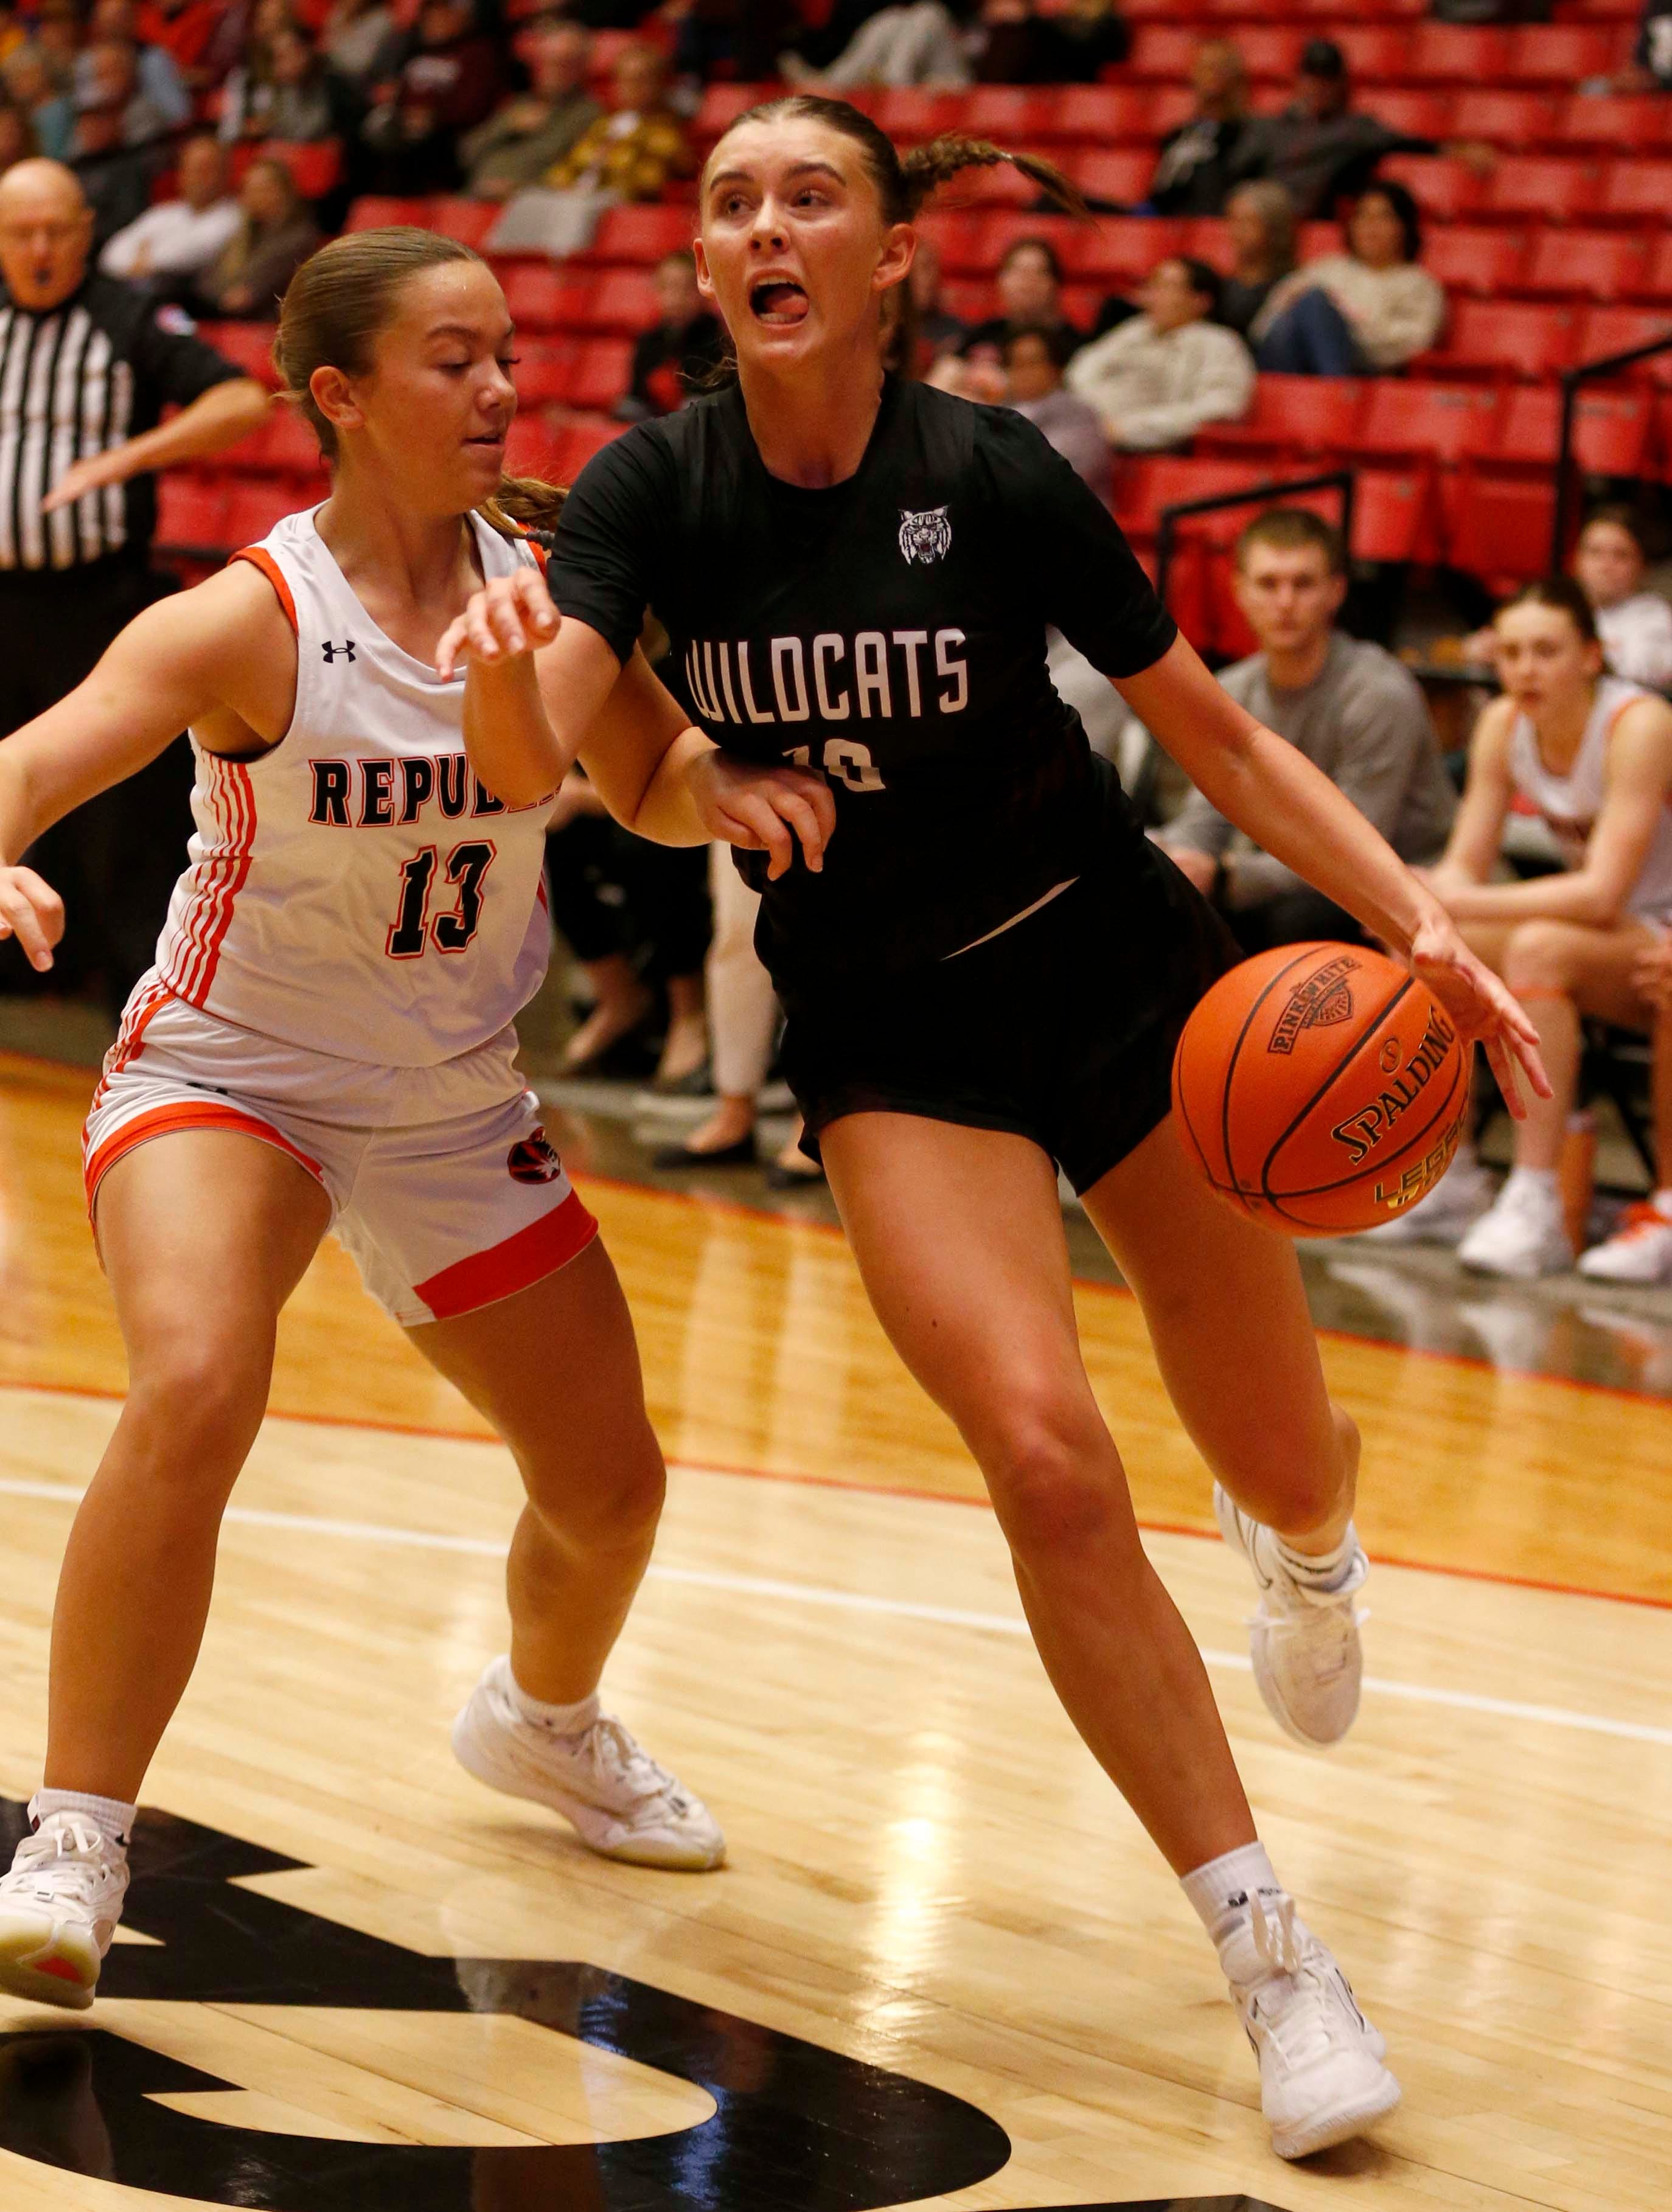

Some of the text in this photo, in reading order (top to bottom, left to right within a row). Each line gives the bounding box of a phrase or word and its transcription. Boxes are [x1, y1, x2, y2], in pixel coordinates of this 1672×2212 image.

[686, 628, 969, 724] WILDCATS
[385, 839, 498, 961] 13
[1331, 1003, 1456, 1165] SPALDING
